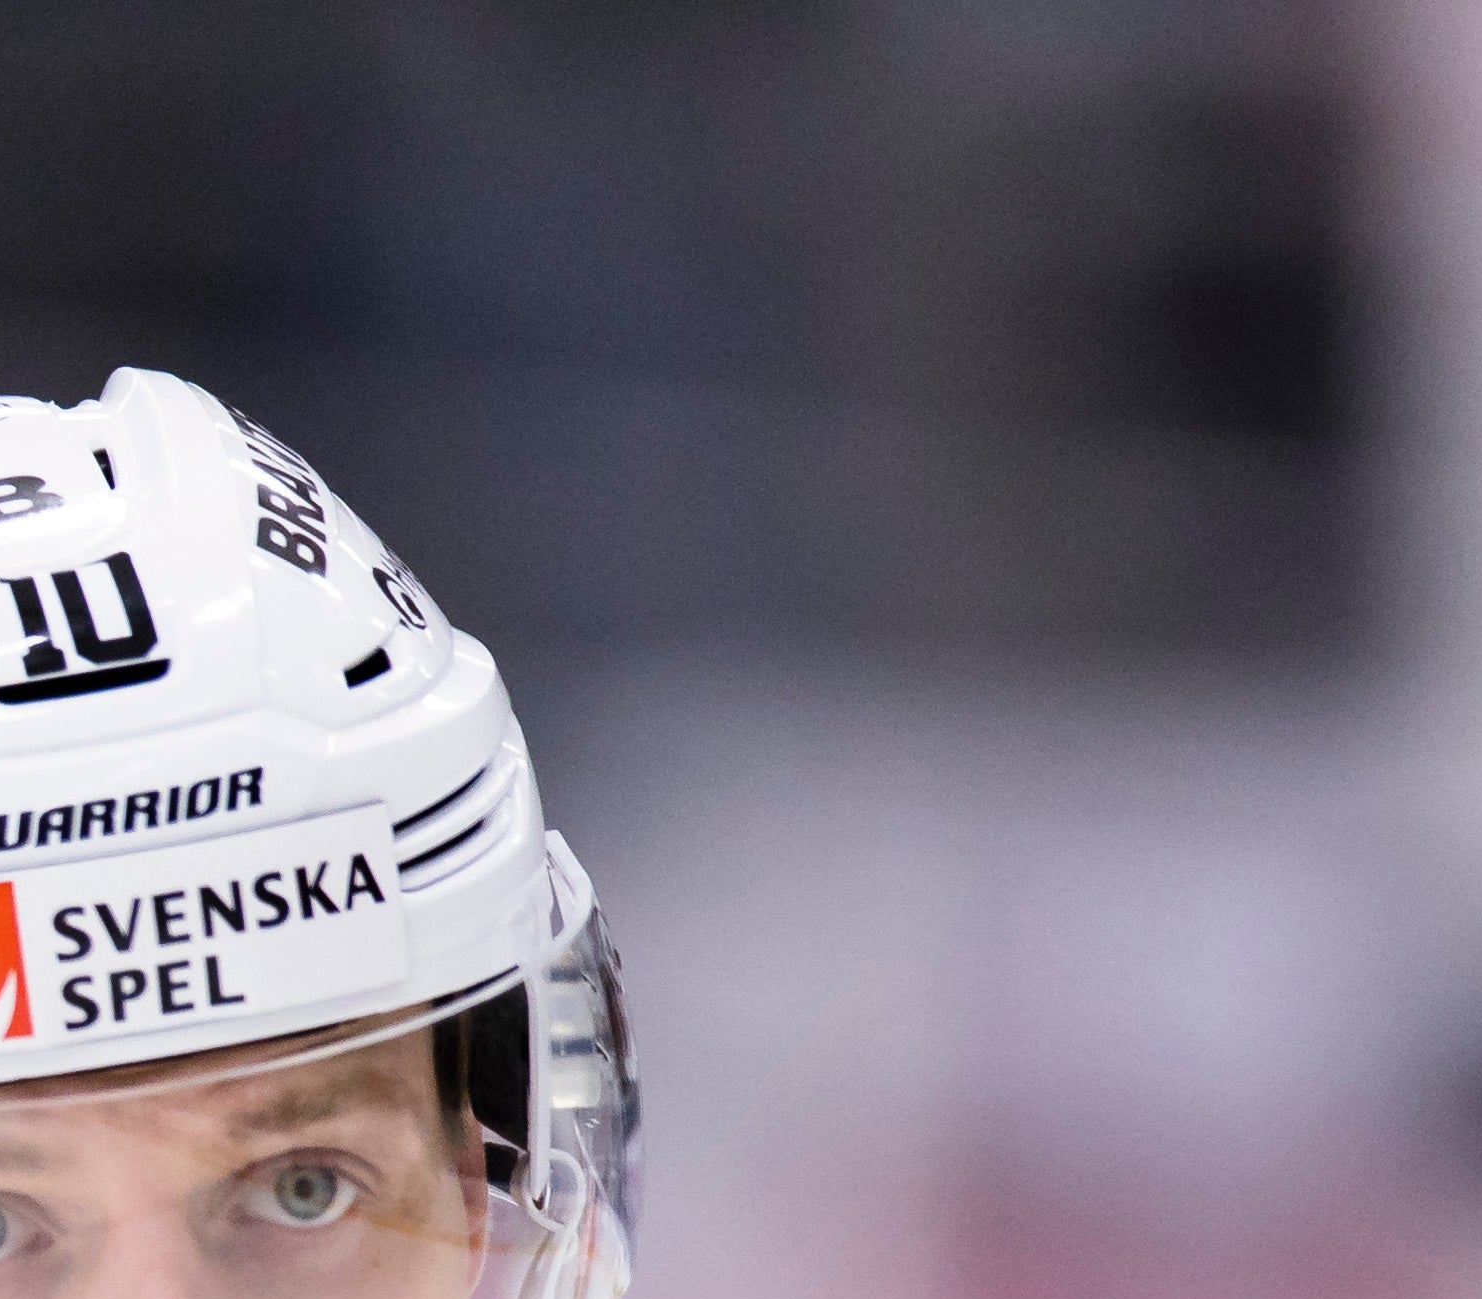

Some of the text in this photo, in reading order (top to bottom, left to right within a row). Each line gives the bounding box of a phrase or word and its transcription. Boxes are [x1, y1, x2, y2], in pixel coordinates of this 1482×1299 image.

[0, 551, 158, 677] 10
[51, 852, 387, 963] SVENSKA
[61, 953, 245, 1032] SPEL
